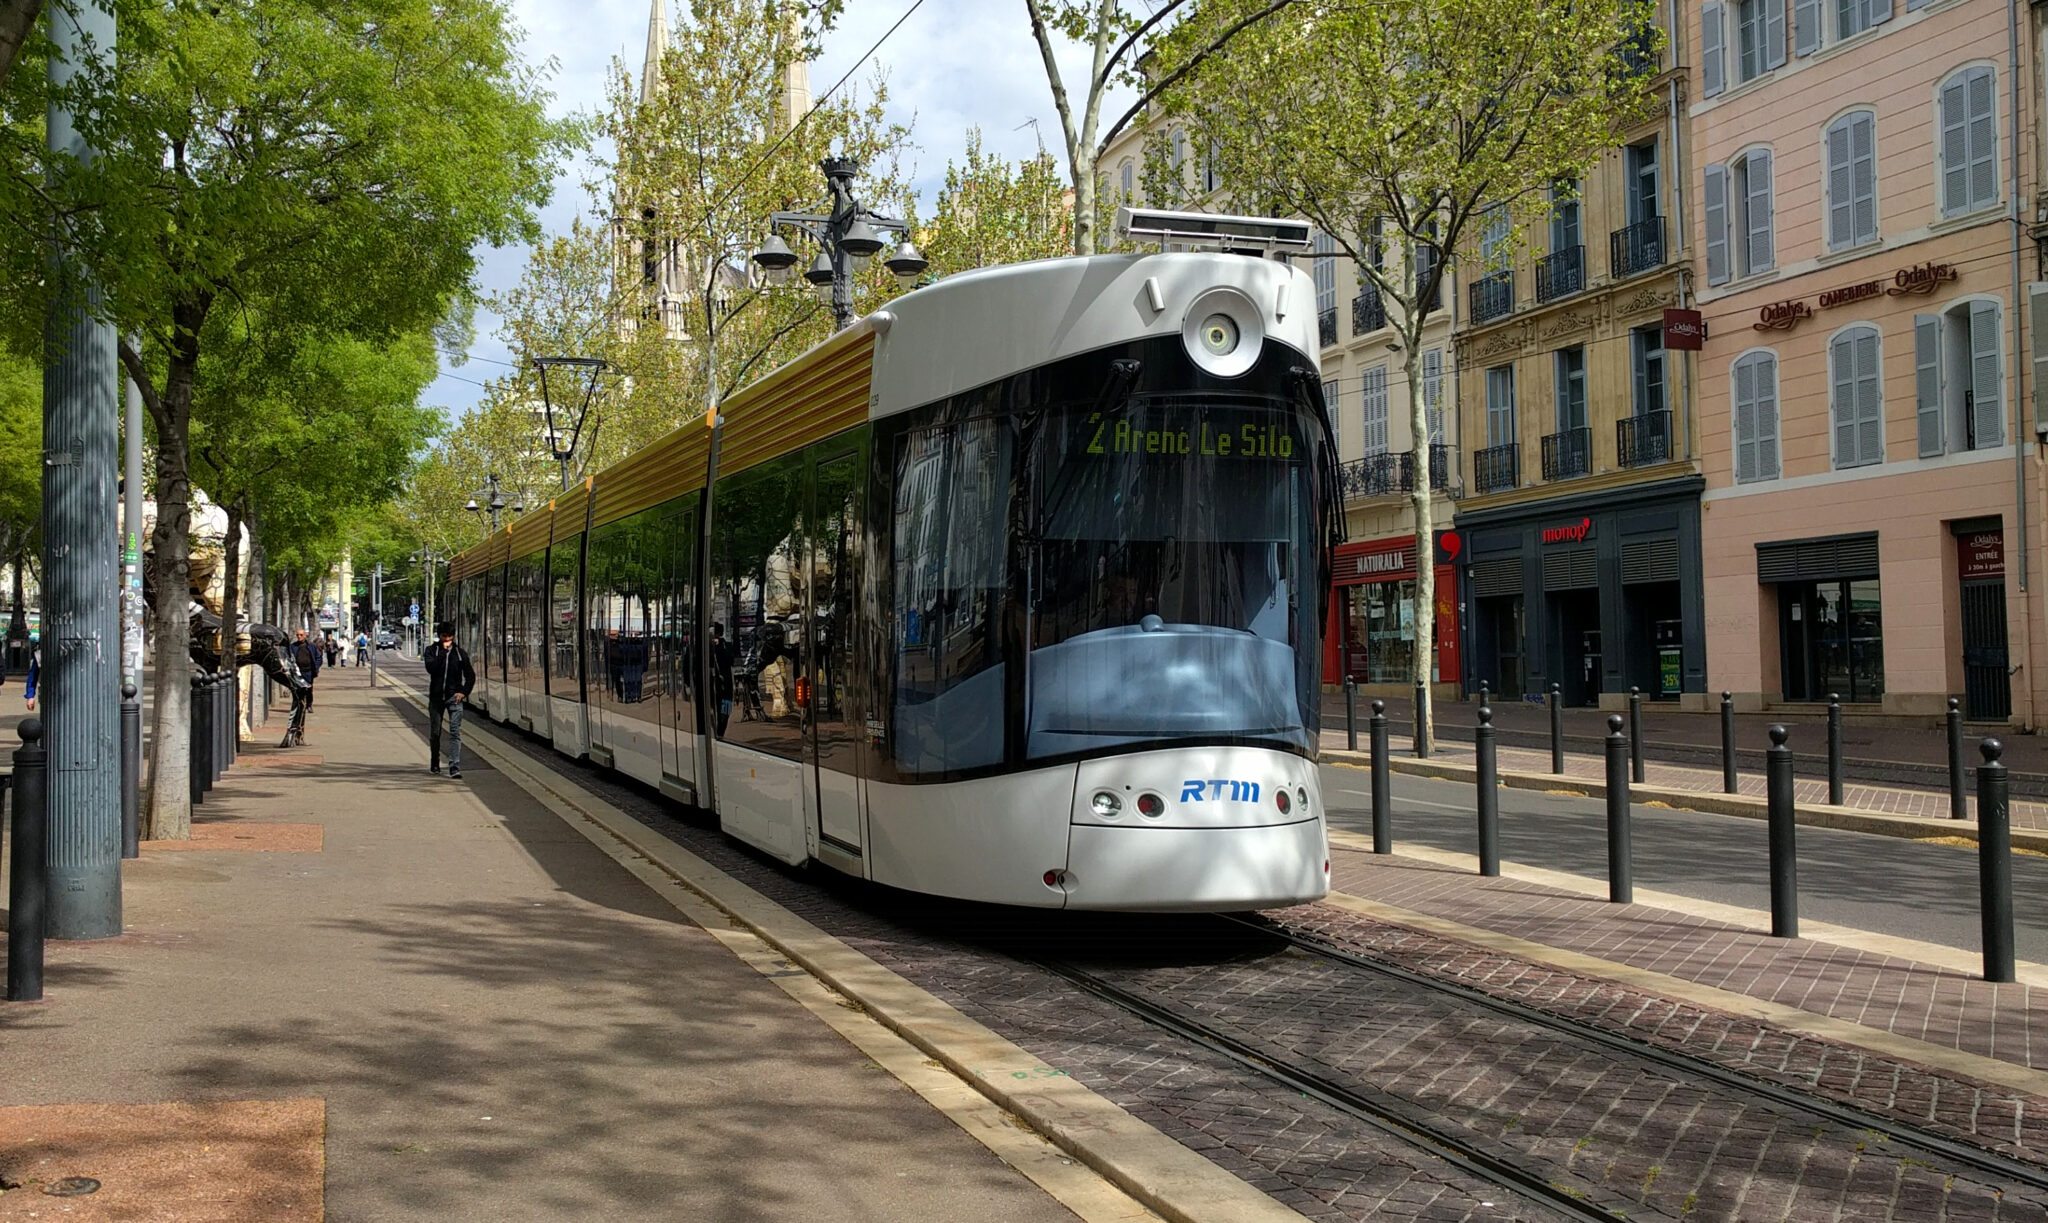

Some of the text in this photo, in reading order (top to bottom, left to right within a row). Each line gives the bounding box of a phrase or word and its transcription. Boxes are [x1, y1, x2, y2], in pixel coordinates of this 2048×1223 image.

[1887, 262, 1957, 296] Odalys
[1753, 301, 1812, 331] Odalys
[1669, 322, 1699, 336] Odalys
[1087, 412, 1292, 457] 2 Arenc Le Silo
[1970, 535, 2002, 548] Odalys
[1356, 552, 1404, 574] NATURALIA
[1180, 779, 1260, 803] RTM
